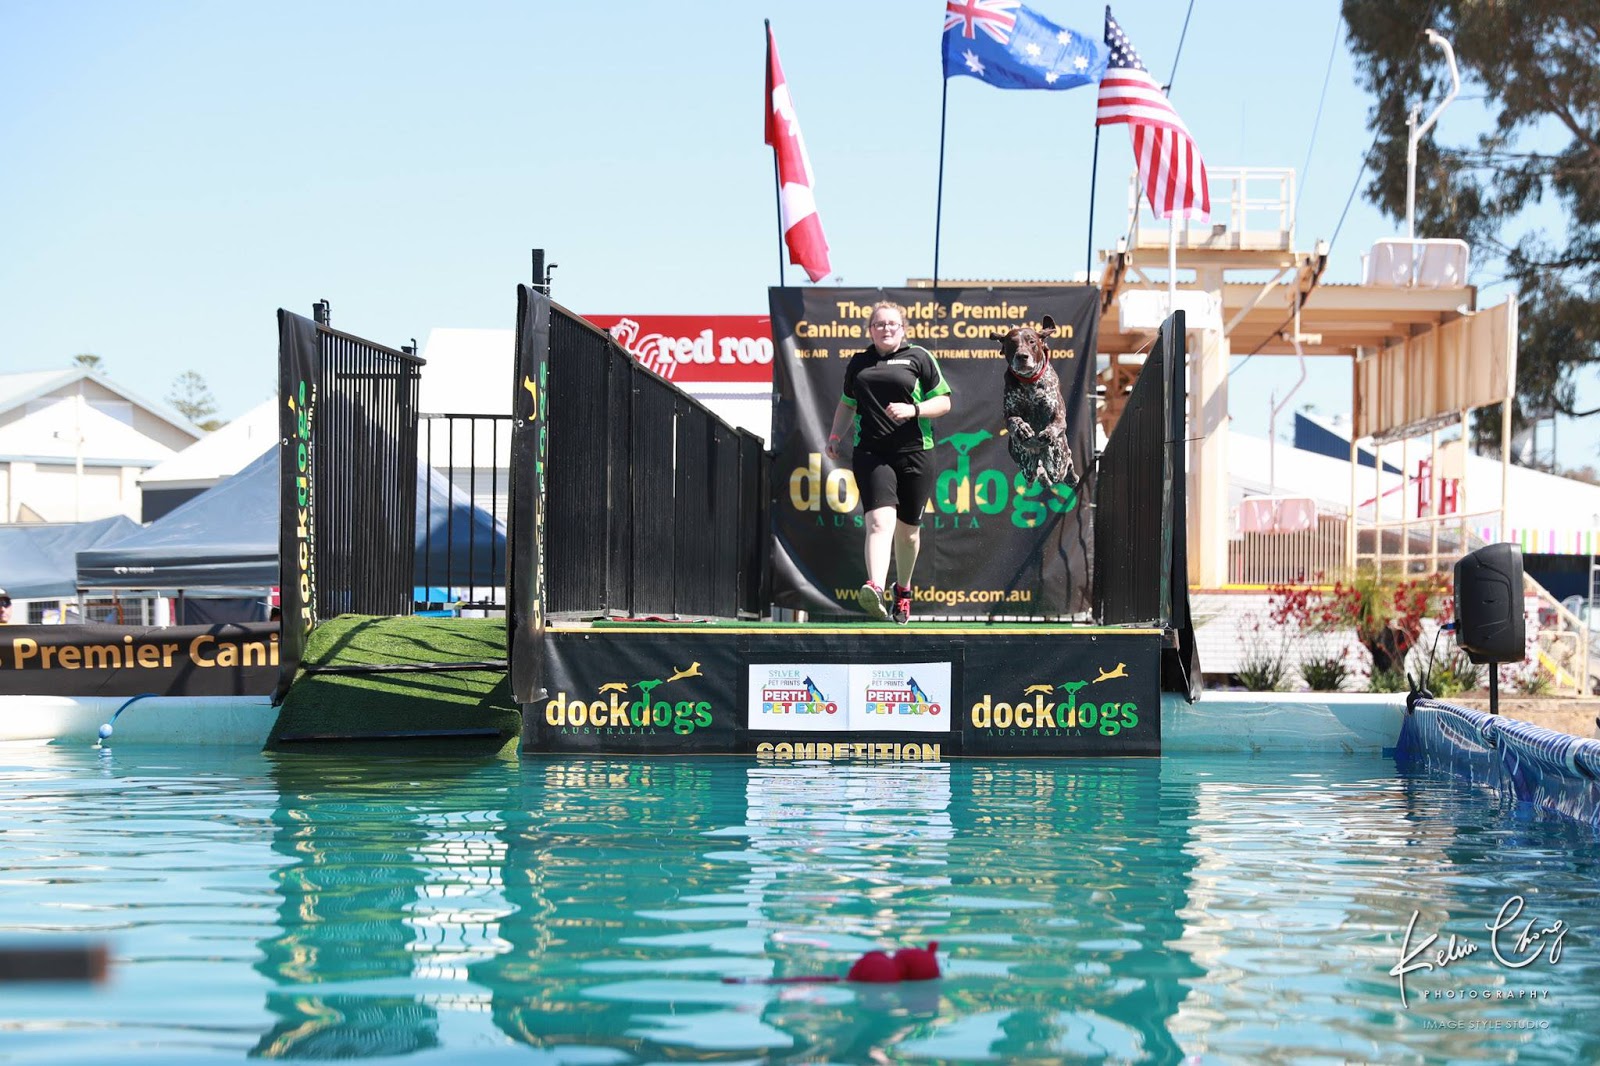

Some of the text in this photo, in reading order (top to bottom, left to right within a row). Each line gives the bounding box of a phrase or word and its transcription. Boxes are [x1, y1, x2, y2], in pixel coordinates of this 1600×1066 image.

[836, 301, 1028, 319] The rld's Premier
[795, 320, 862, 338] Canine
[656, 328, 774, 365] red roo
[812, 349, 828, 358] AIR
[929, 349, 970, 359] XTREME
[1053, 349, 1075, 358] DOG
[789, 453, 1078, 528] dodogs
[13, 633, 279, 670] Premier Cani
[764, 690, 807, 701] PERTH
[868, 691, 911, 702] PERTH
[545, 692, 713, 735] dockdogs
[762, 702, 838, 714] PET EXPO
[865, 703, 941, 715] PET EXPO
[971, 694, 1139, 736] dockdogs
[561, 727, 656, 735] AUSTRALIA
[987, 729, 1082, 737] AUSTRALIA
